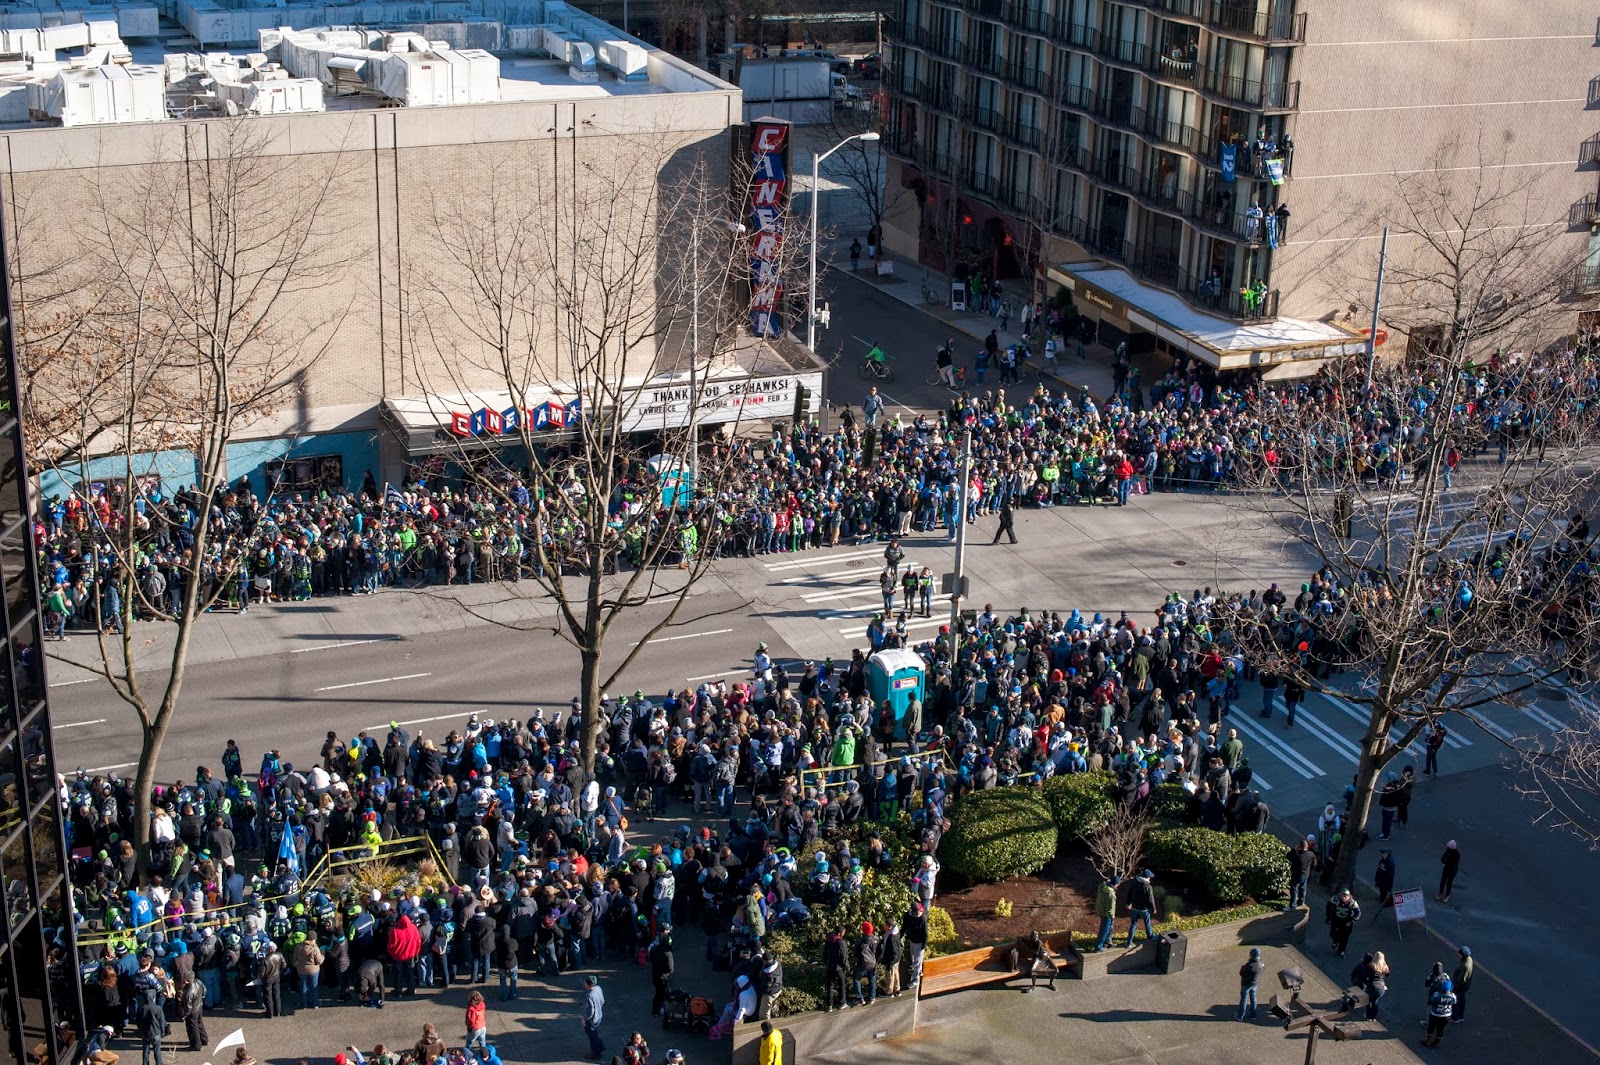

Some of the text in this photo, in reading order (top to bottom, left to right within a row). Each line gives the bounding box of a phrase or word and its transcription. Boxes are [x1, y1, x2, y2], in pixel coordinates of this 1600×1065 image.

[1222, 153, 1234, 172] 12
[753, 128, 782, 336] CINERAMA
[653, 389, 688, 402] THANK
[638, 404, 676, 416] LAWRECE
[732, 397, 740, 406] IN
[456, 404, 579, 434] CINERAMA
